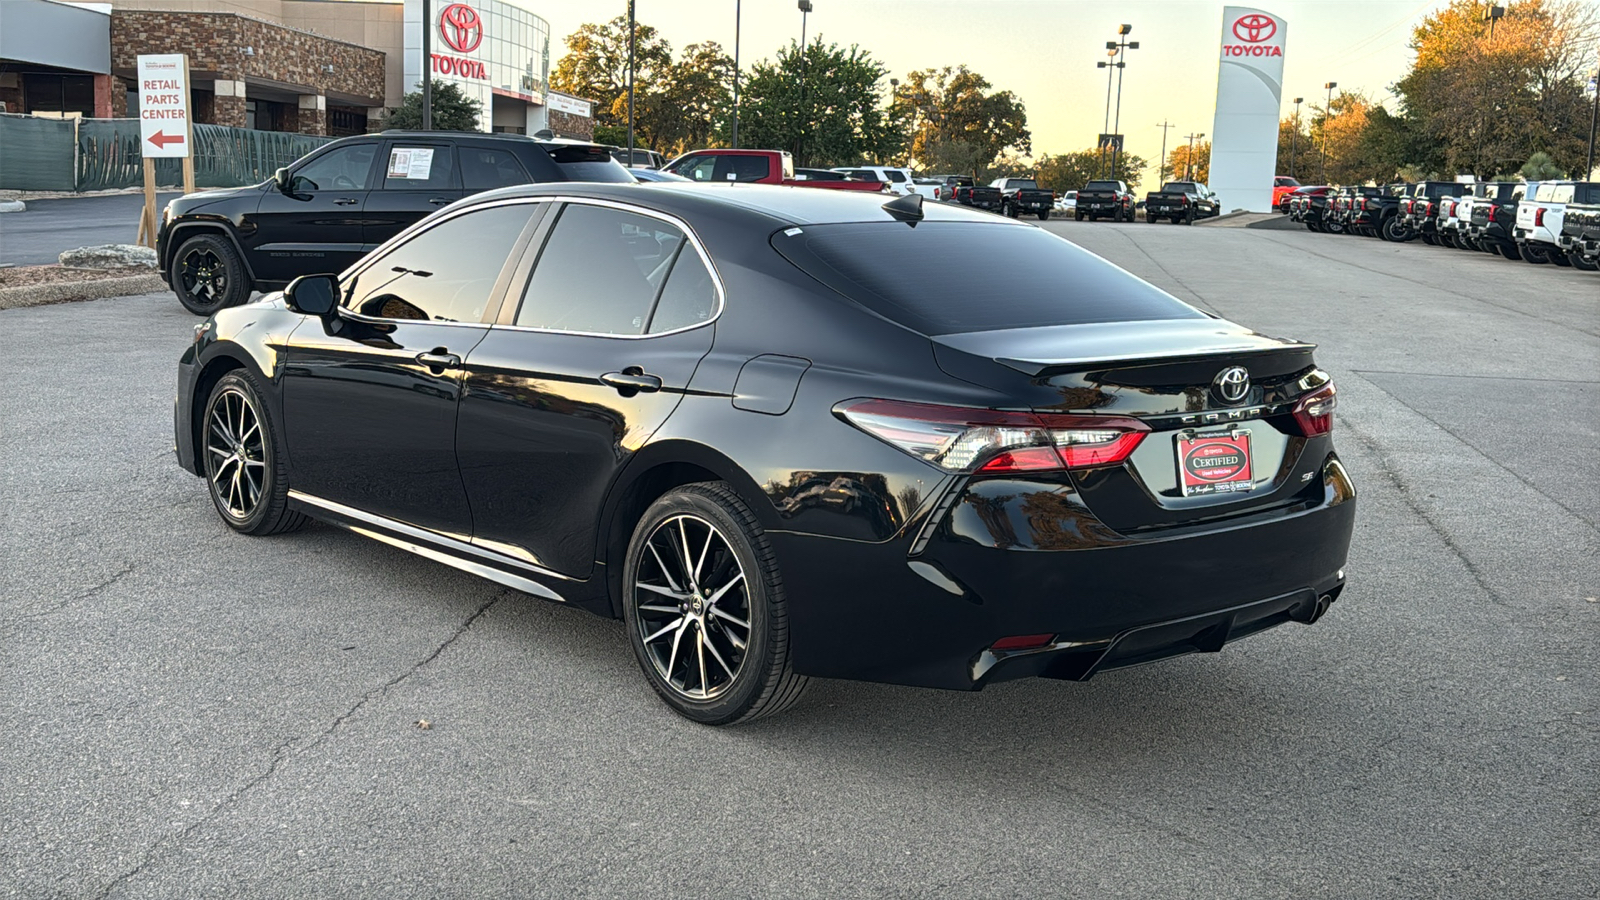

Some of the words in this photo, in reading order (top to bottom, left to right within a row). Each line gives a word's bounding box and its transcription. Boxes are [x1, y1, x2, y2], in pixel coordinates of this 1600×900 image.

[1223, 44, 1282, 57] TOYOTA
[430, 54, 487, 80] TOYOTA
[144, 80, 180, 90] RETAIL
[146, 95, 179, 104] PARTS
[142, 109, 185, 119] CENTER
[1193, 456, 1238, 468] CERTIFIED
